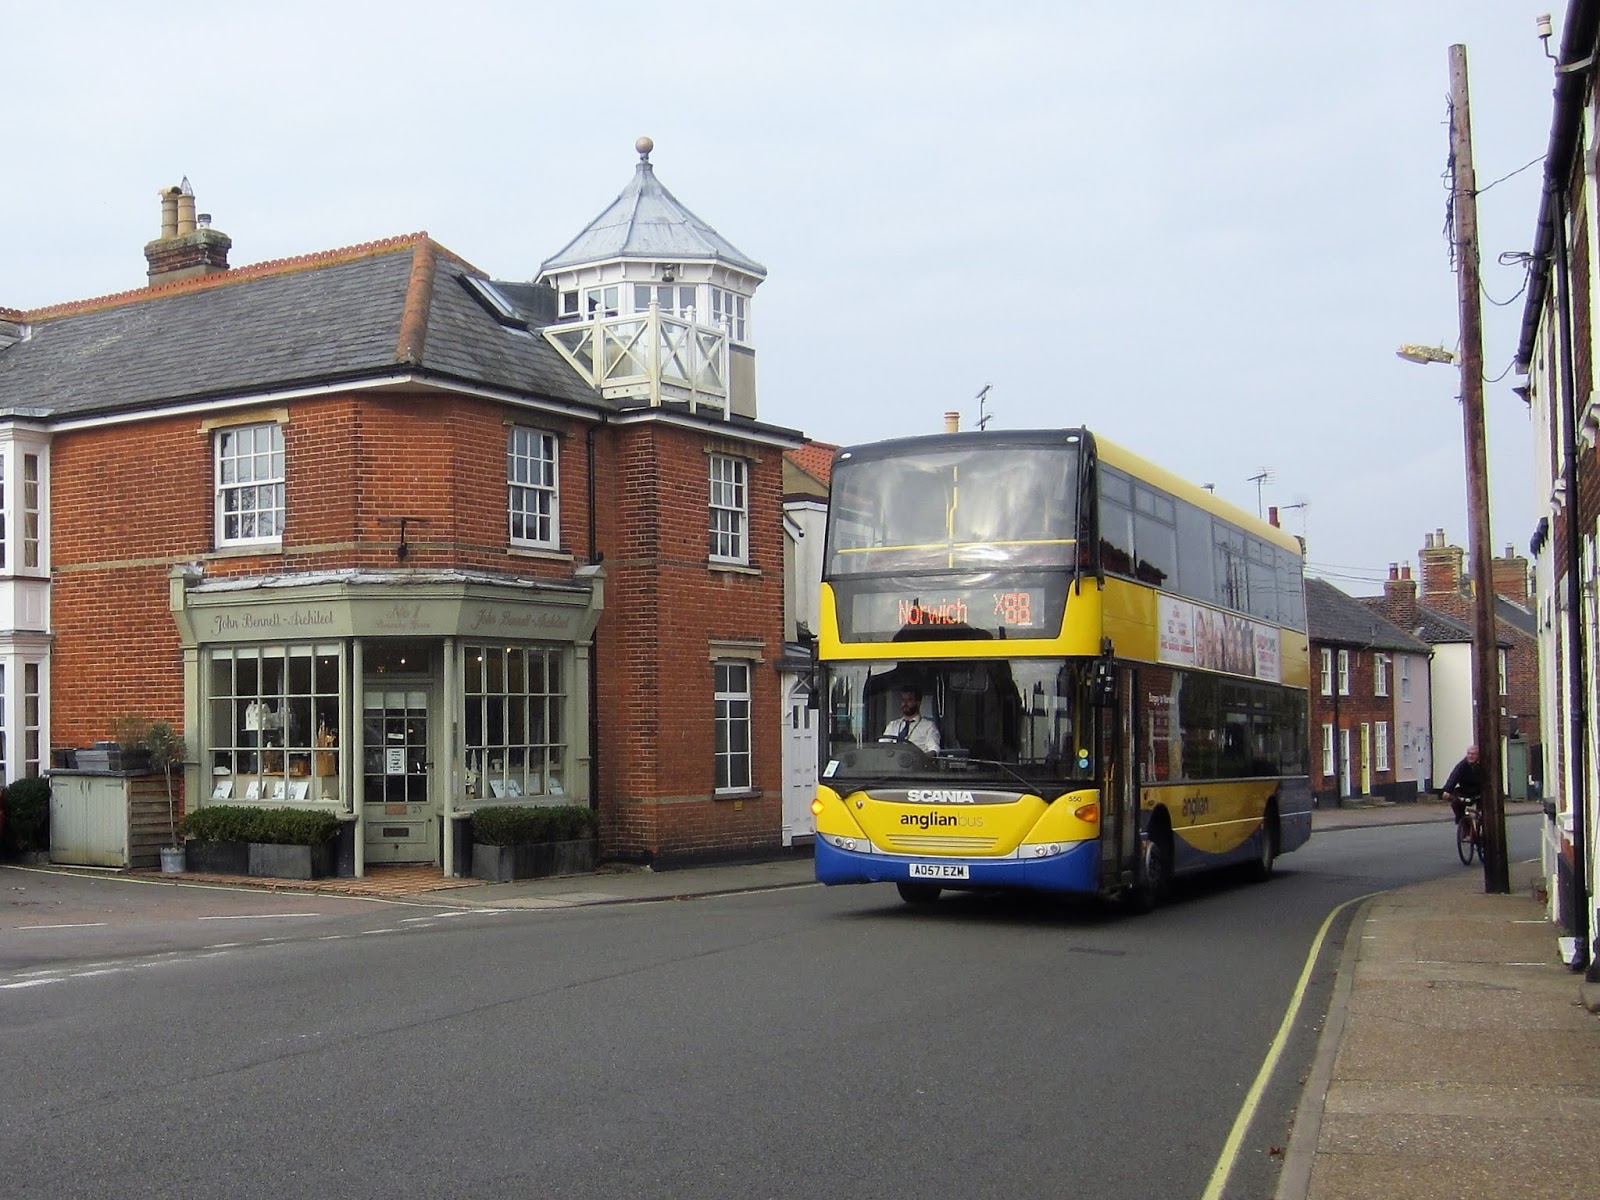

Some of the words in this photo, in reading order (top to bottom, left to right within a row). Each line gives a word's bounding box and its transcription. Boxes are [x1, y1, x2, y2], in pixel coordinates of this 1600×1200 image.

[898, 598, 968, 625] Norwich
[993, 593, 1031, 624] X88
[211, 614, 238, 636] John
[242, 612, 279, 628] Bennett
[288, 609, 333, 625] Architect
[907, 789, 975, 803] SCANIA
[1068, 795, 1083, 803] 550
[900, 811, 984, 830] anglianbus
[943, 866, 965, 877] EZM
